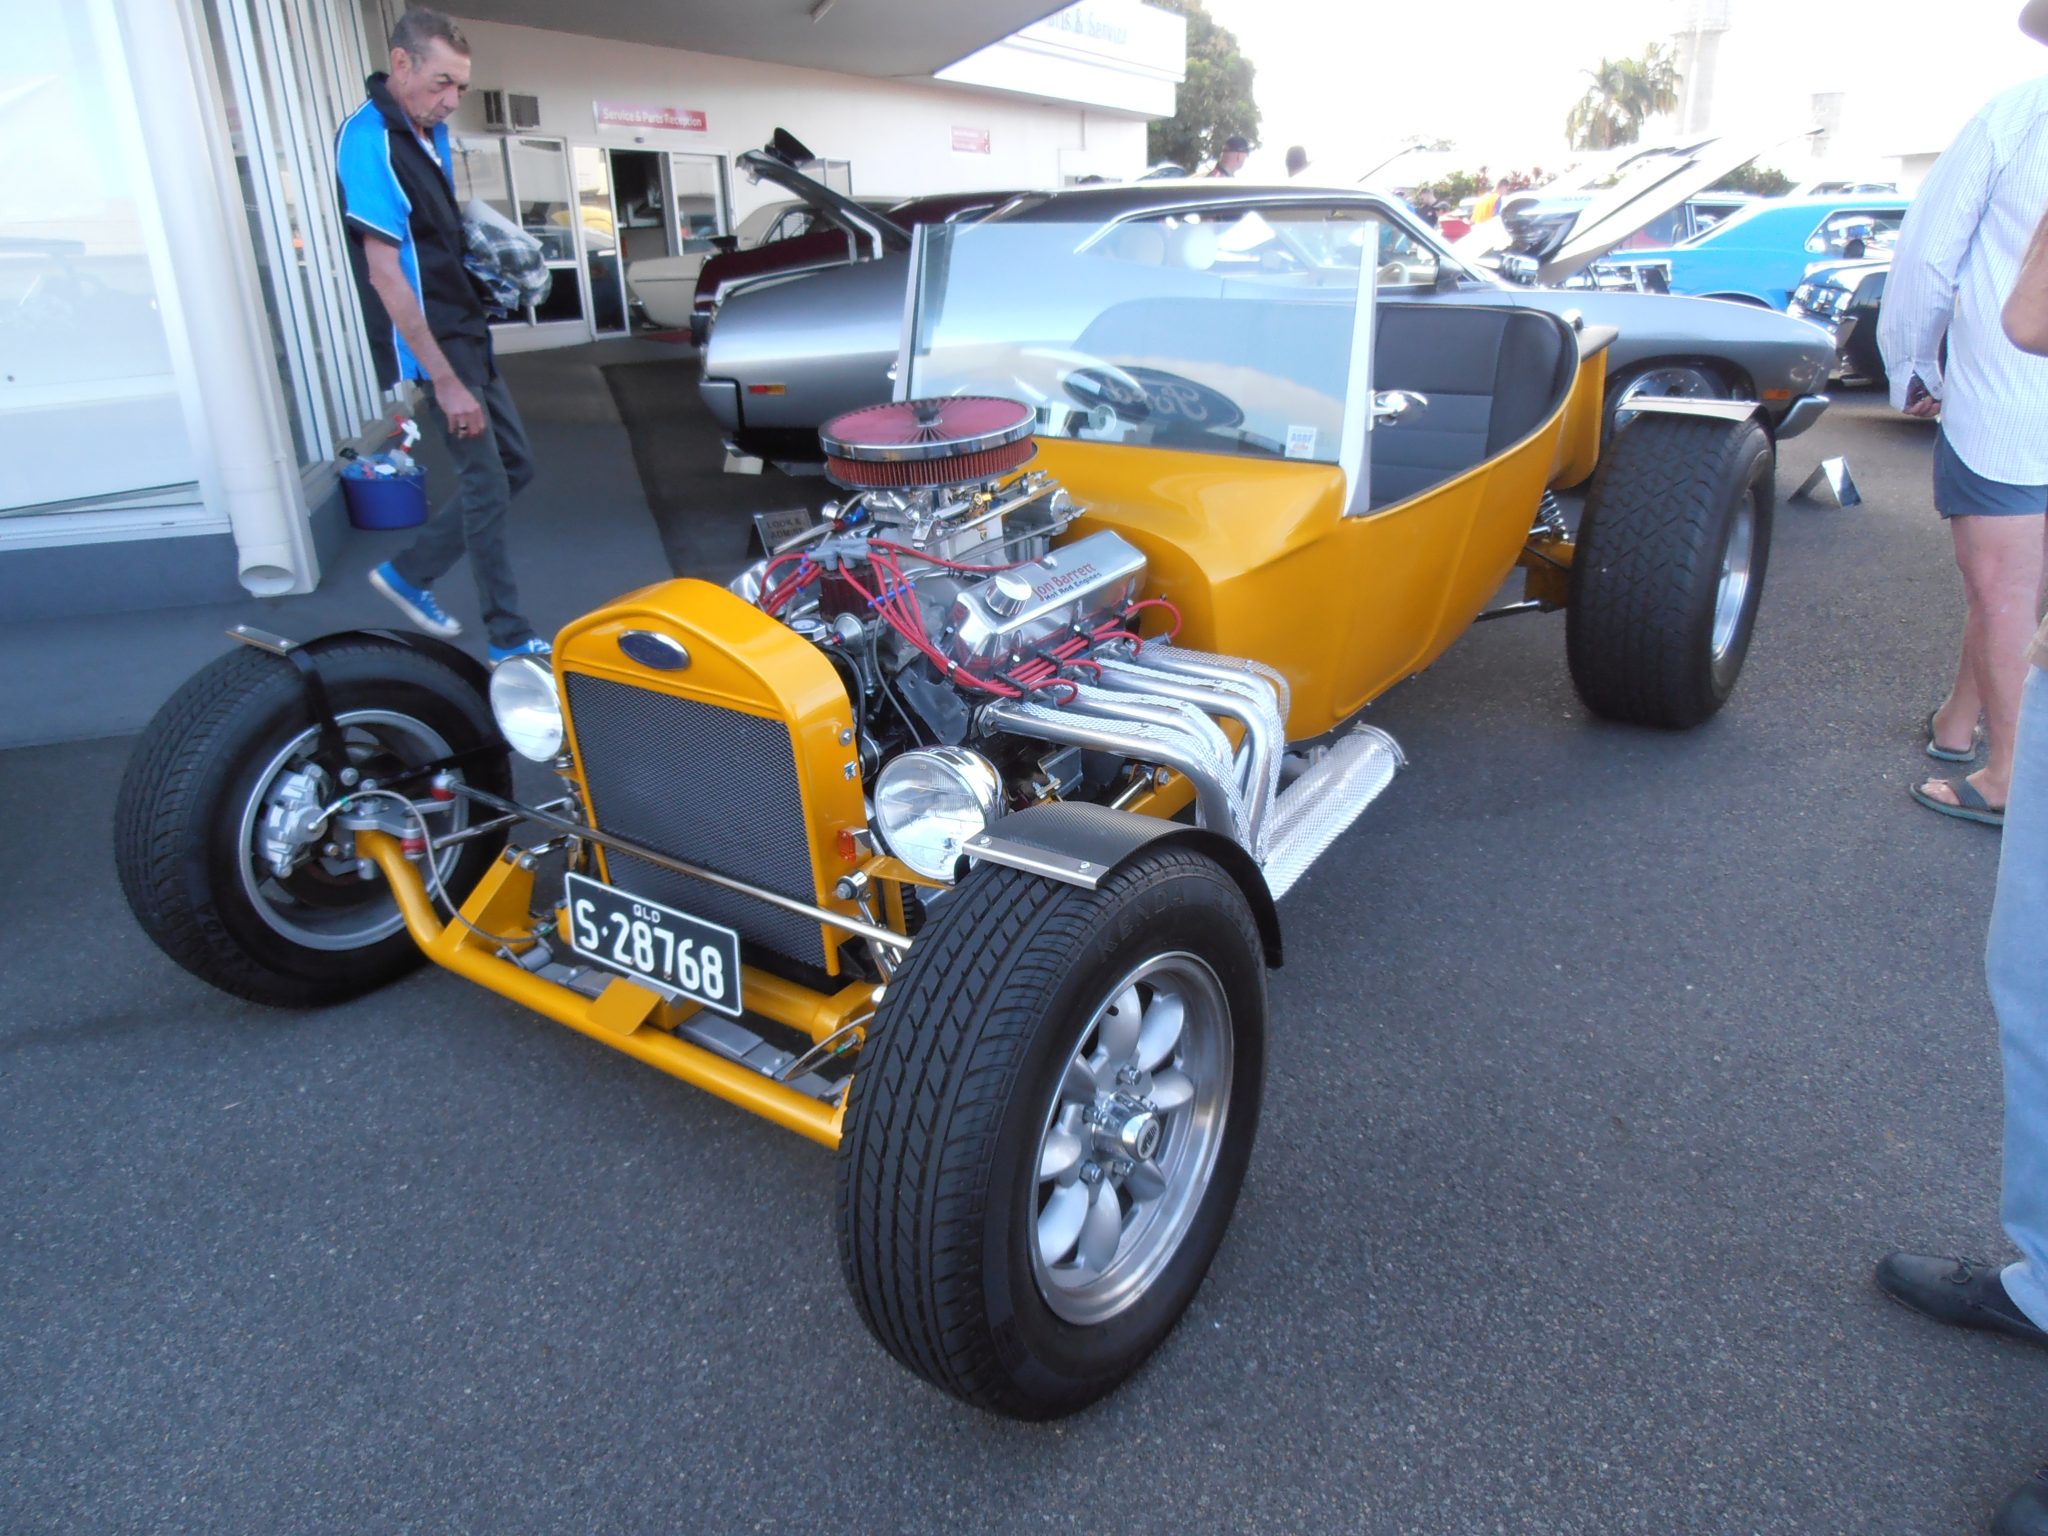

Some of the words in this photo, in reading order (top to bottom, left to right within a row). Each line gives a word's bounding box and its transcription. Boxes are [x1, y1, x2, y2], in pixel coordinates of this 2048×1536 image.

[1088, 12, 1127, 45] Service
[602, 107, 634, 121] Service
[643, 112, 663, 124] Parts
[664, 113, 702, 128] Reception
[766, 519, 792, 529] LOOK
[1032, 581, 1055, 602] Jon
[1051, 563, 1096, 587] Barrett
[1045, 590, 1059, 600] Hot
[1059, 584, 1074, 595] Rod
[1074, 572, 1102, 587] Engines
[632, 903, 661, 924] QLD
